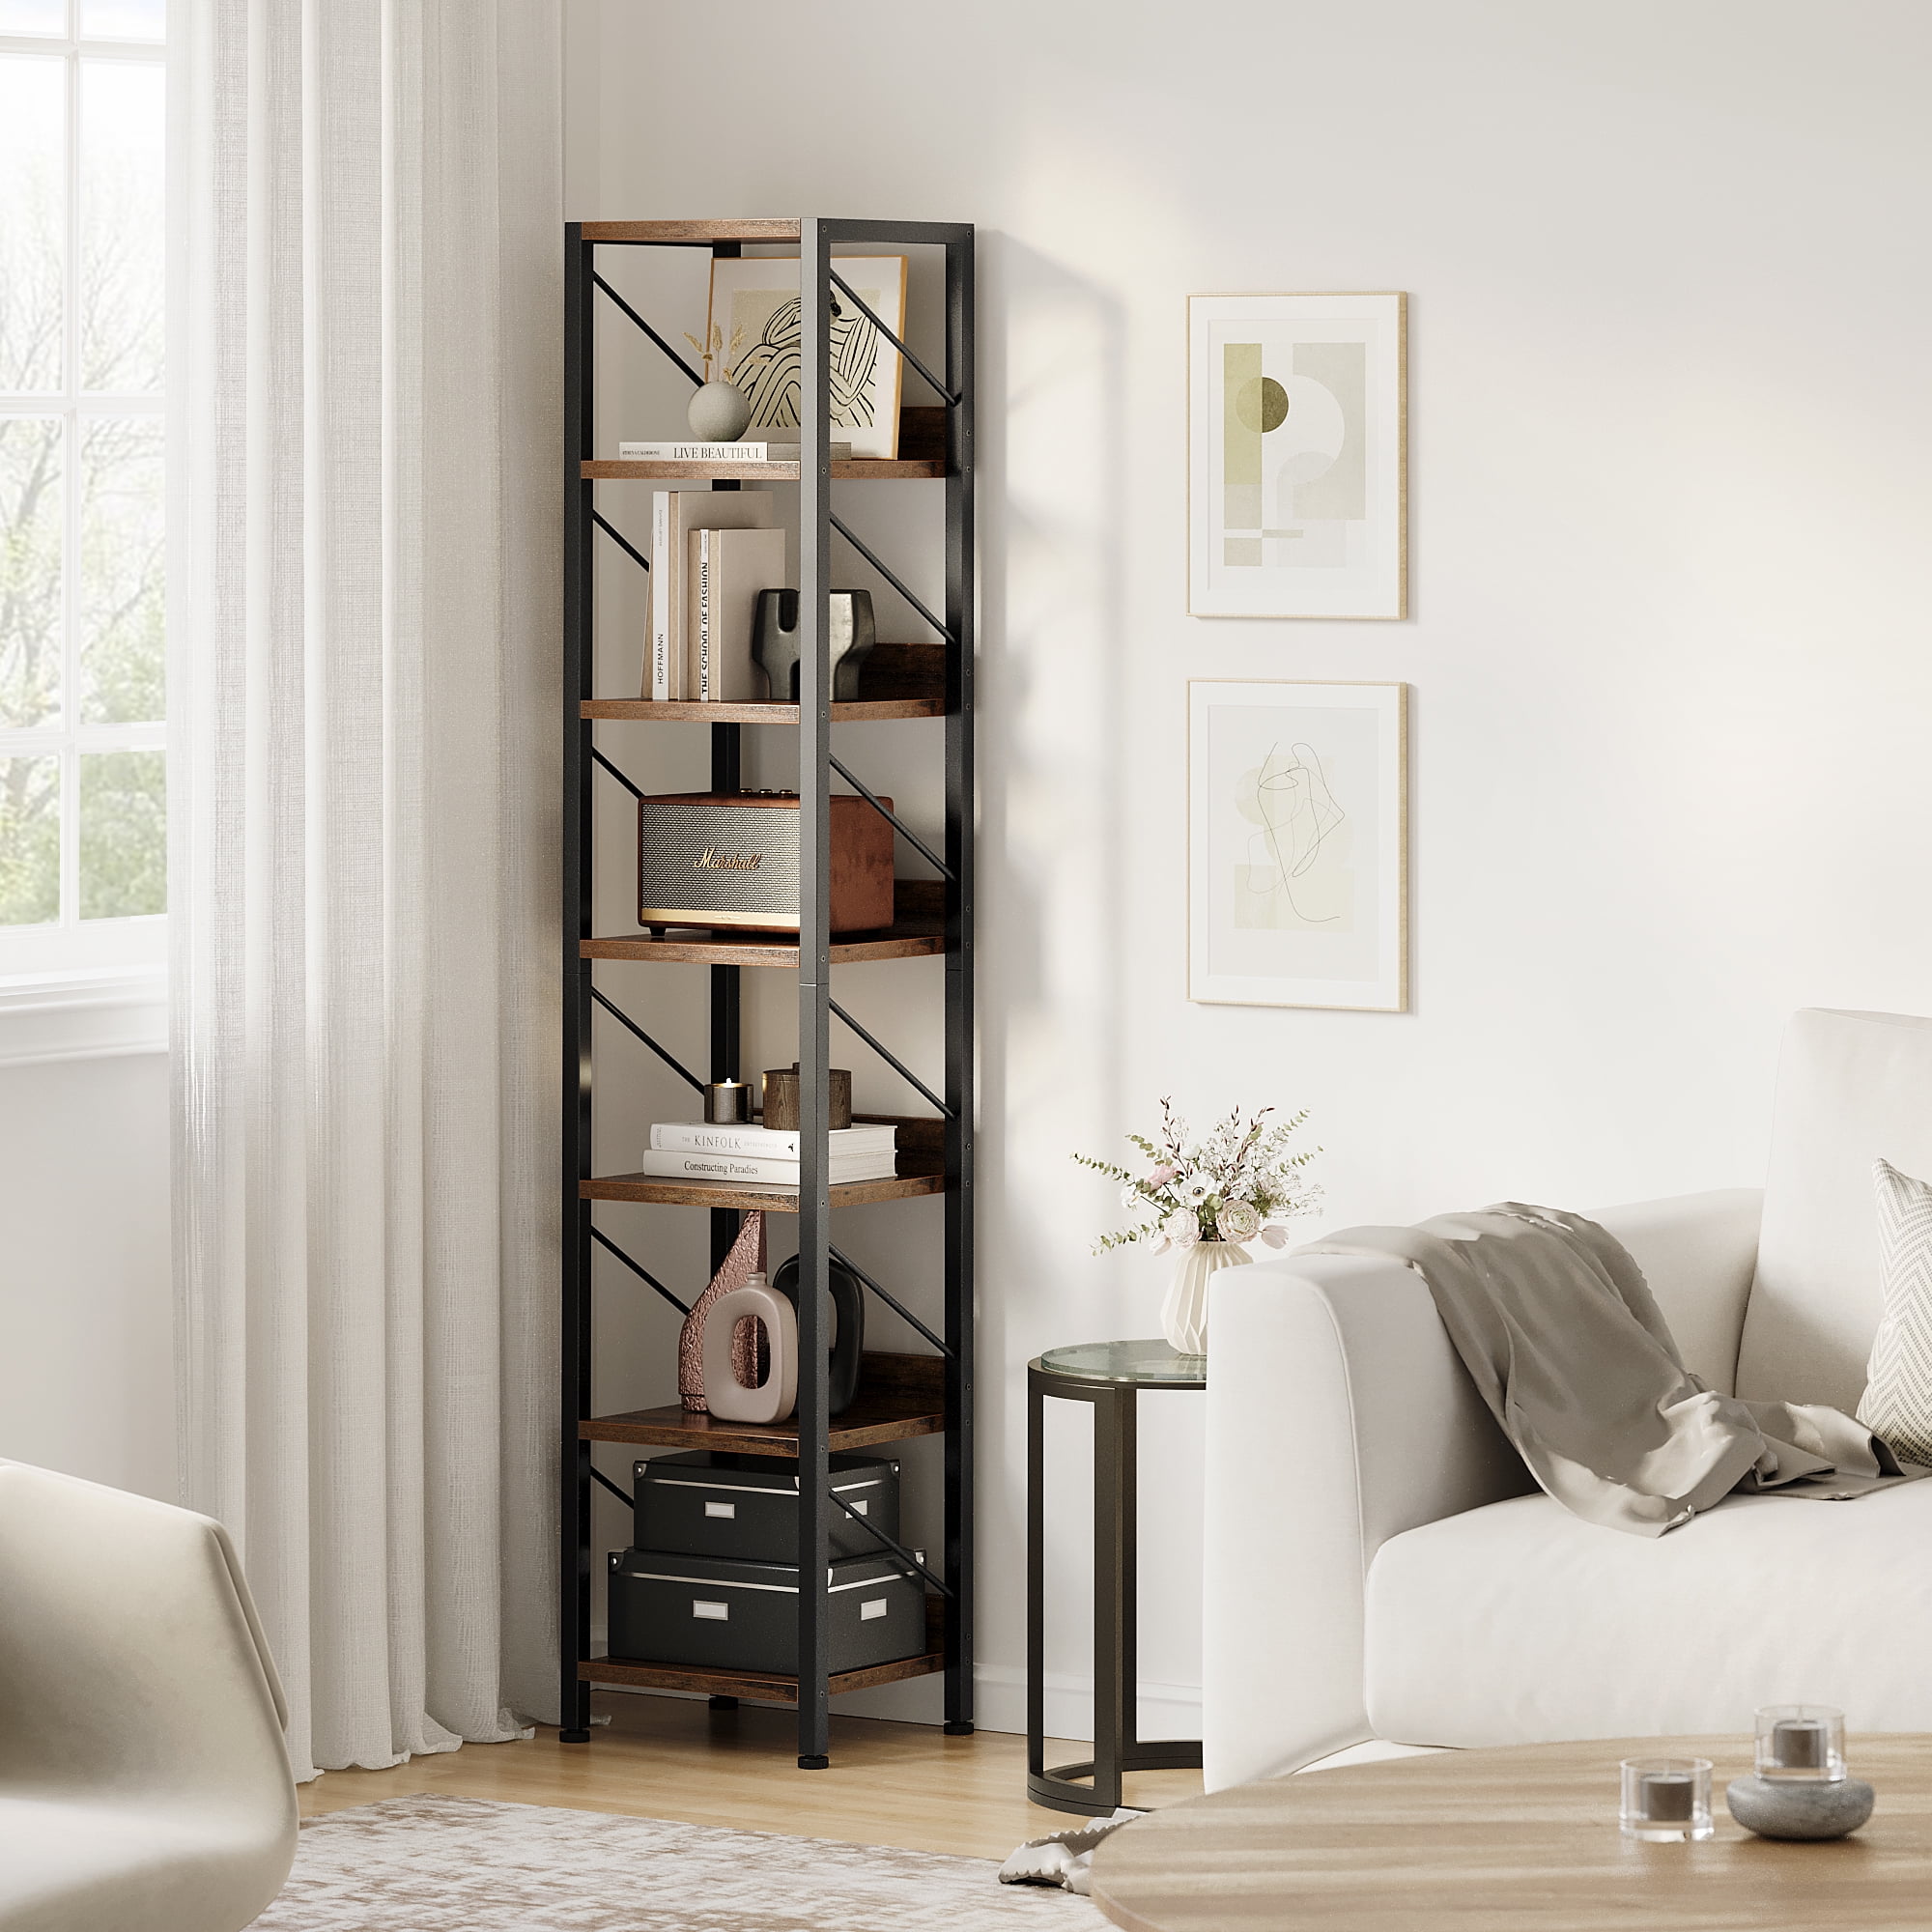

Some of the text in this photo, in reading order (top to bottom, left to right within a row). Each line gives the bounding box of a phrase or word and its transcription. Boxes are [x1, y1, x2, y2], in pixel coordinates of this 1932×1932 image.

[673, 447, 762, 459] LIVE BEAUTIFUL
[701, 611, 708, 625] OF
[694, 846, 762, 870] Marshall
[695, 1135, 742, 1150] KINFOLK
[684, 1160, 758, 1176] Constructing Paradies
